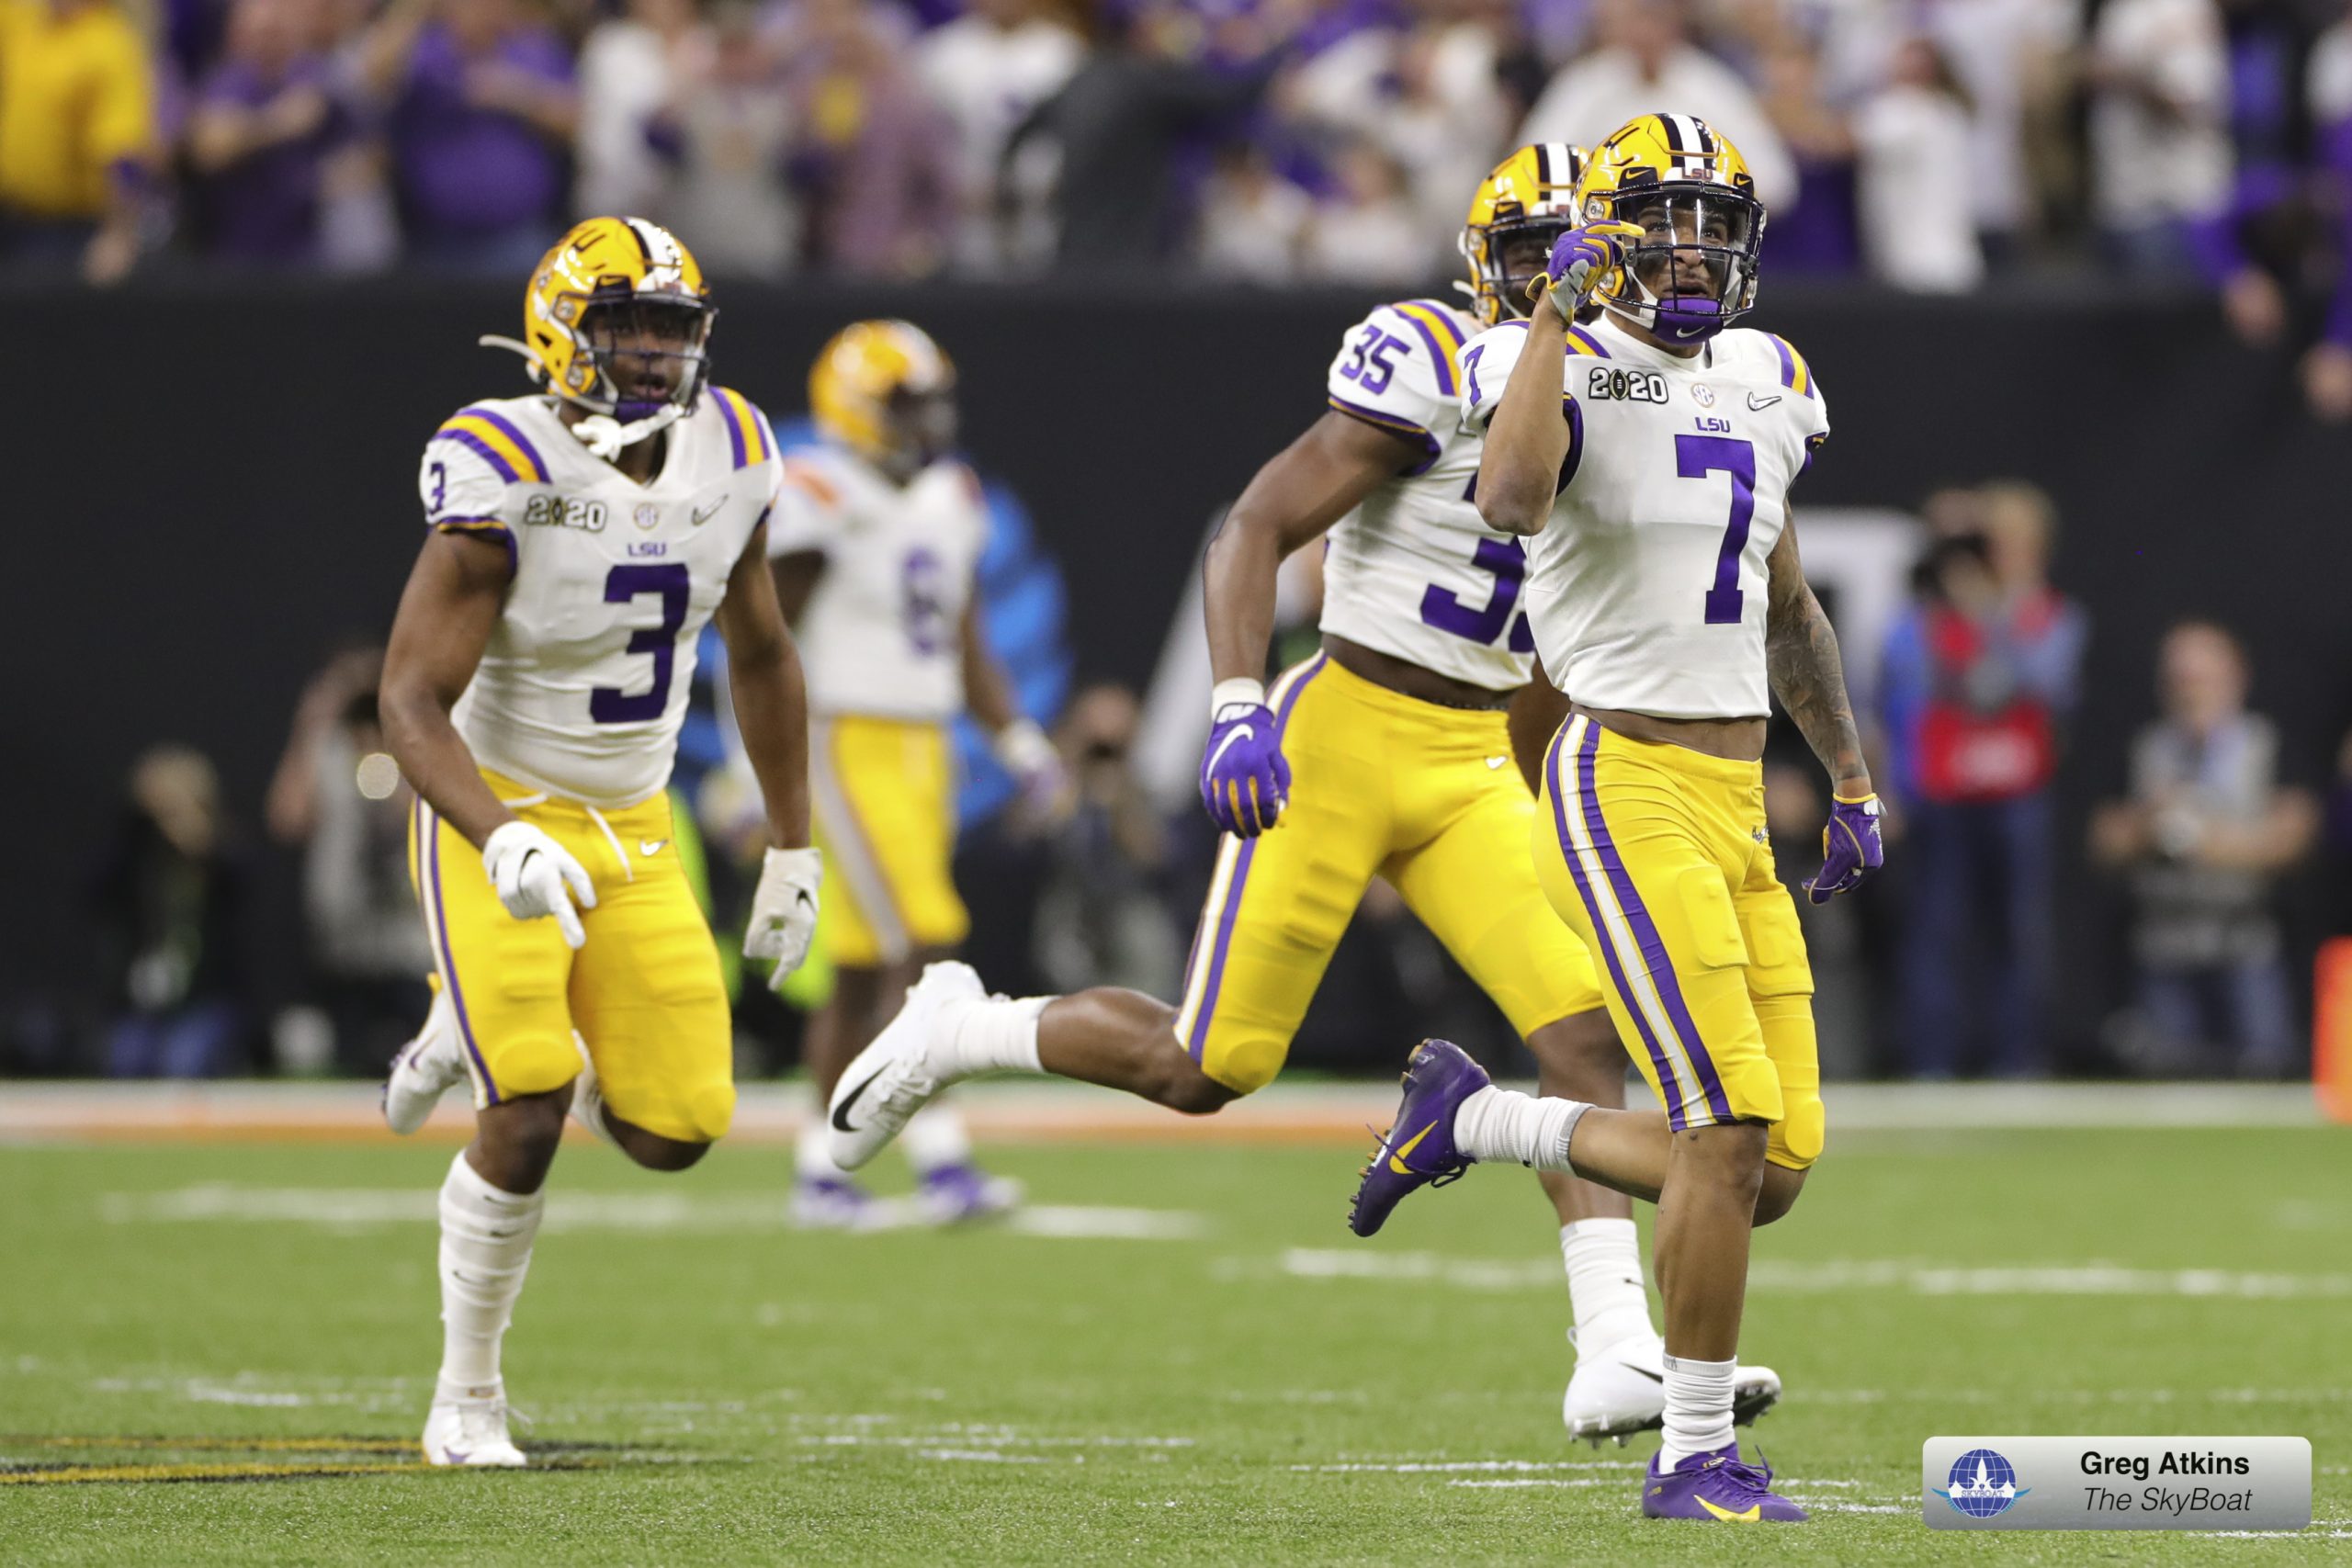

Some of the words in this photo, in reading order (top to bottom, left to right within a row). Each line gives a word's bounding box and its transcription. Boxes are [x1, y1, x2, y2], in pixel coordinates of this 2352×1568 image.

[1681, 168, 1713, 181] LSU
[1340, 325, 1411, 396] 35
[1464, 344, 1485, 407] 7
[1589, 367, 1668, 404] 2020
[1695, 417, 1730, 433] LSU
[429, 461, 446, 515] 3
[525, 494, 606, 533] 2020
[1674, 434, 1755, 624] 7
[628, 542, 666, 557] LSU
[590, 563, 689, 724] 3
